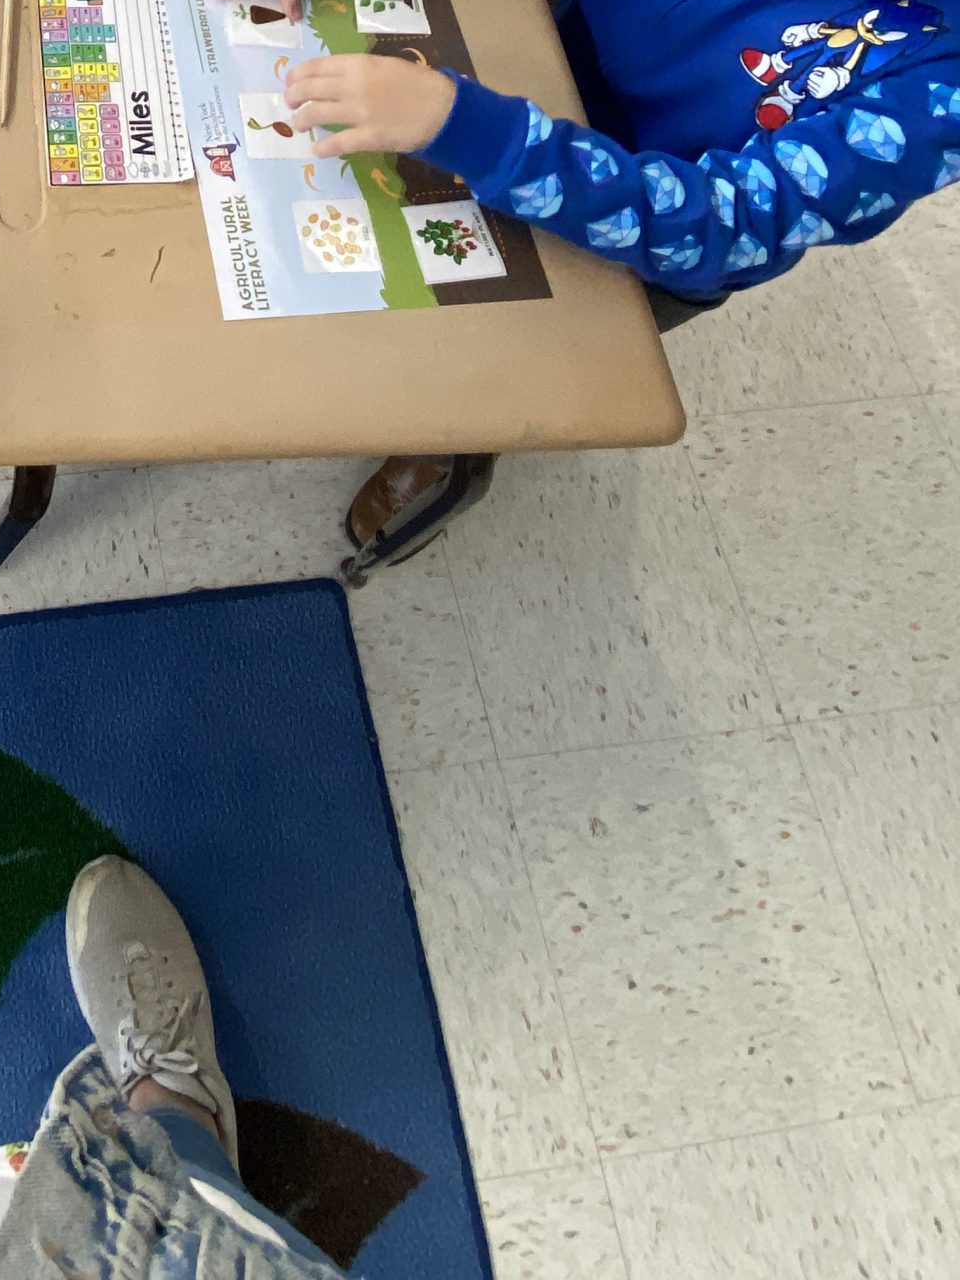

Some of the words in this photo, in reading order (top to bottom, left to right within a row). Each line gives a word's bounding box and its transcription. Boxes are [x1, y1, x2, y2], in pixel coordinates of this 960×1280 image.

[197, 8, 219, 74] STRAWBERRY
[129, 91, 156, 156] Miles
[198, 103, 208, 120] York
[208, 100, 222, 142] Agriculture
[214, 85, 227, 124] Classroom
[203, 122, 212, 142] New
[234, 195, 253, 233] WEEK
[220, 196, 255, 312] AGRICULTURAL
[481, 233, 495, 257] MATURE
[244, 239, 271, 311] LITERACY
